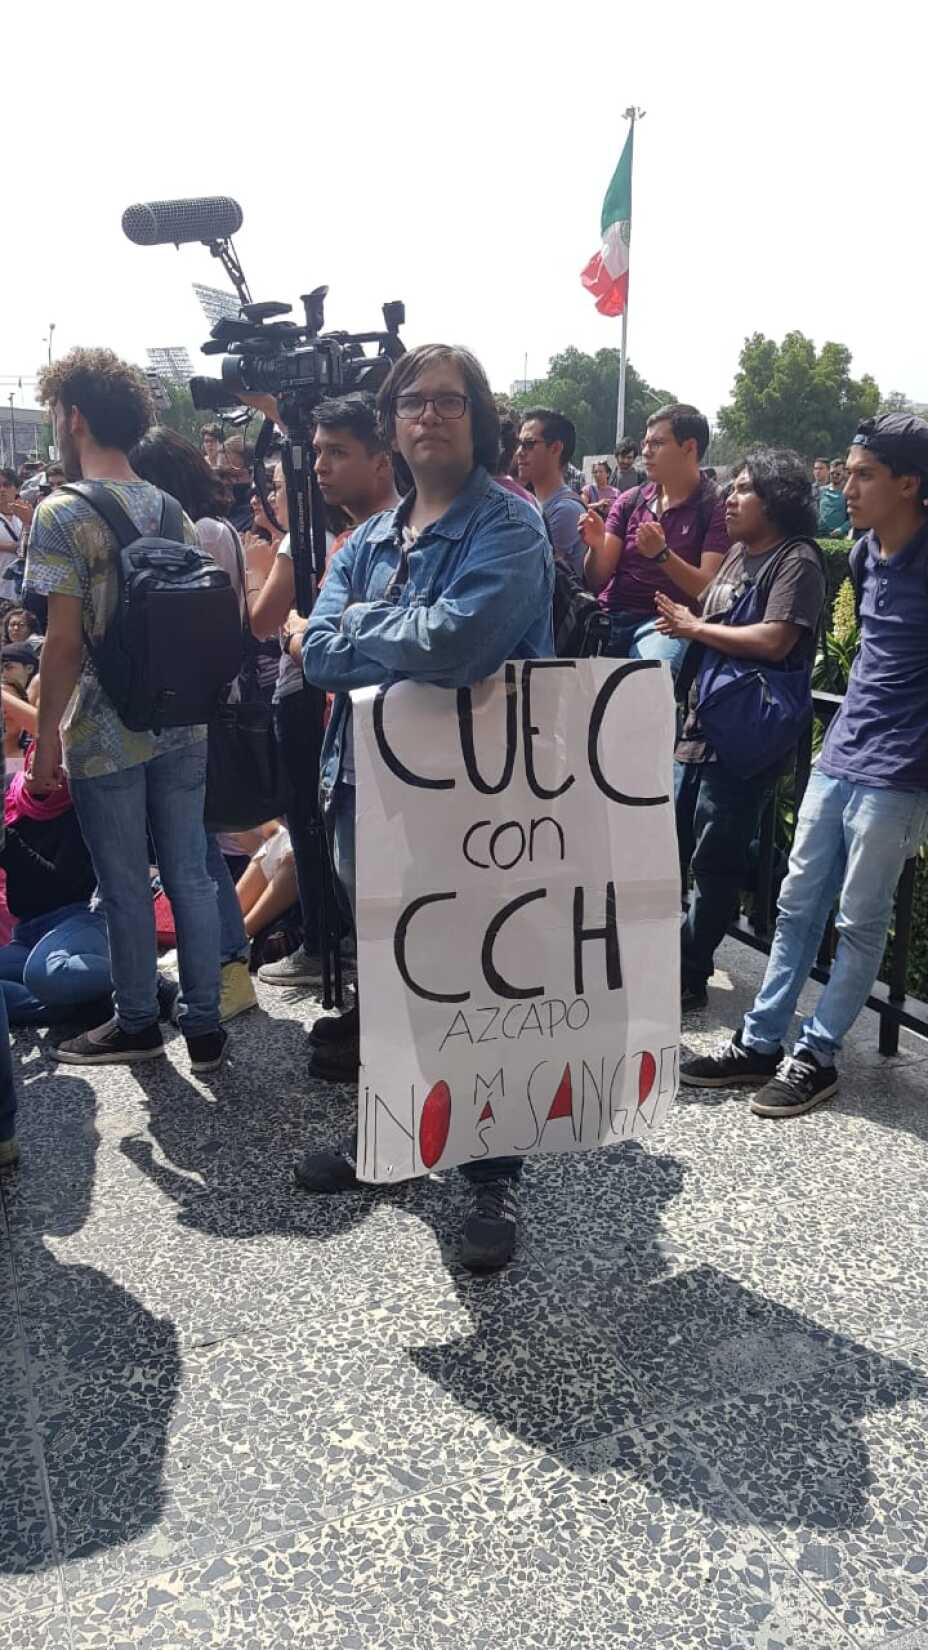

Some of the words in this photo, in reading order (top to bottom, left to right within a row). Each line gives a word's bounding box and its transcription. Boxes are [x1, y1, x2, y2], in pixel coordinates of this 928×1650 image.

[373, 660, 669, 806] CUEC
[463, 817, 565, 870] con
[394, 881, 622, 1003] CCH
[438, 998, 590, 1051] AZCAPO
